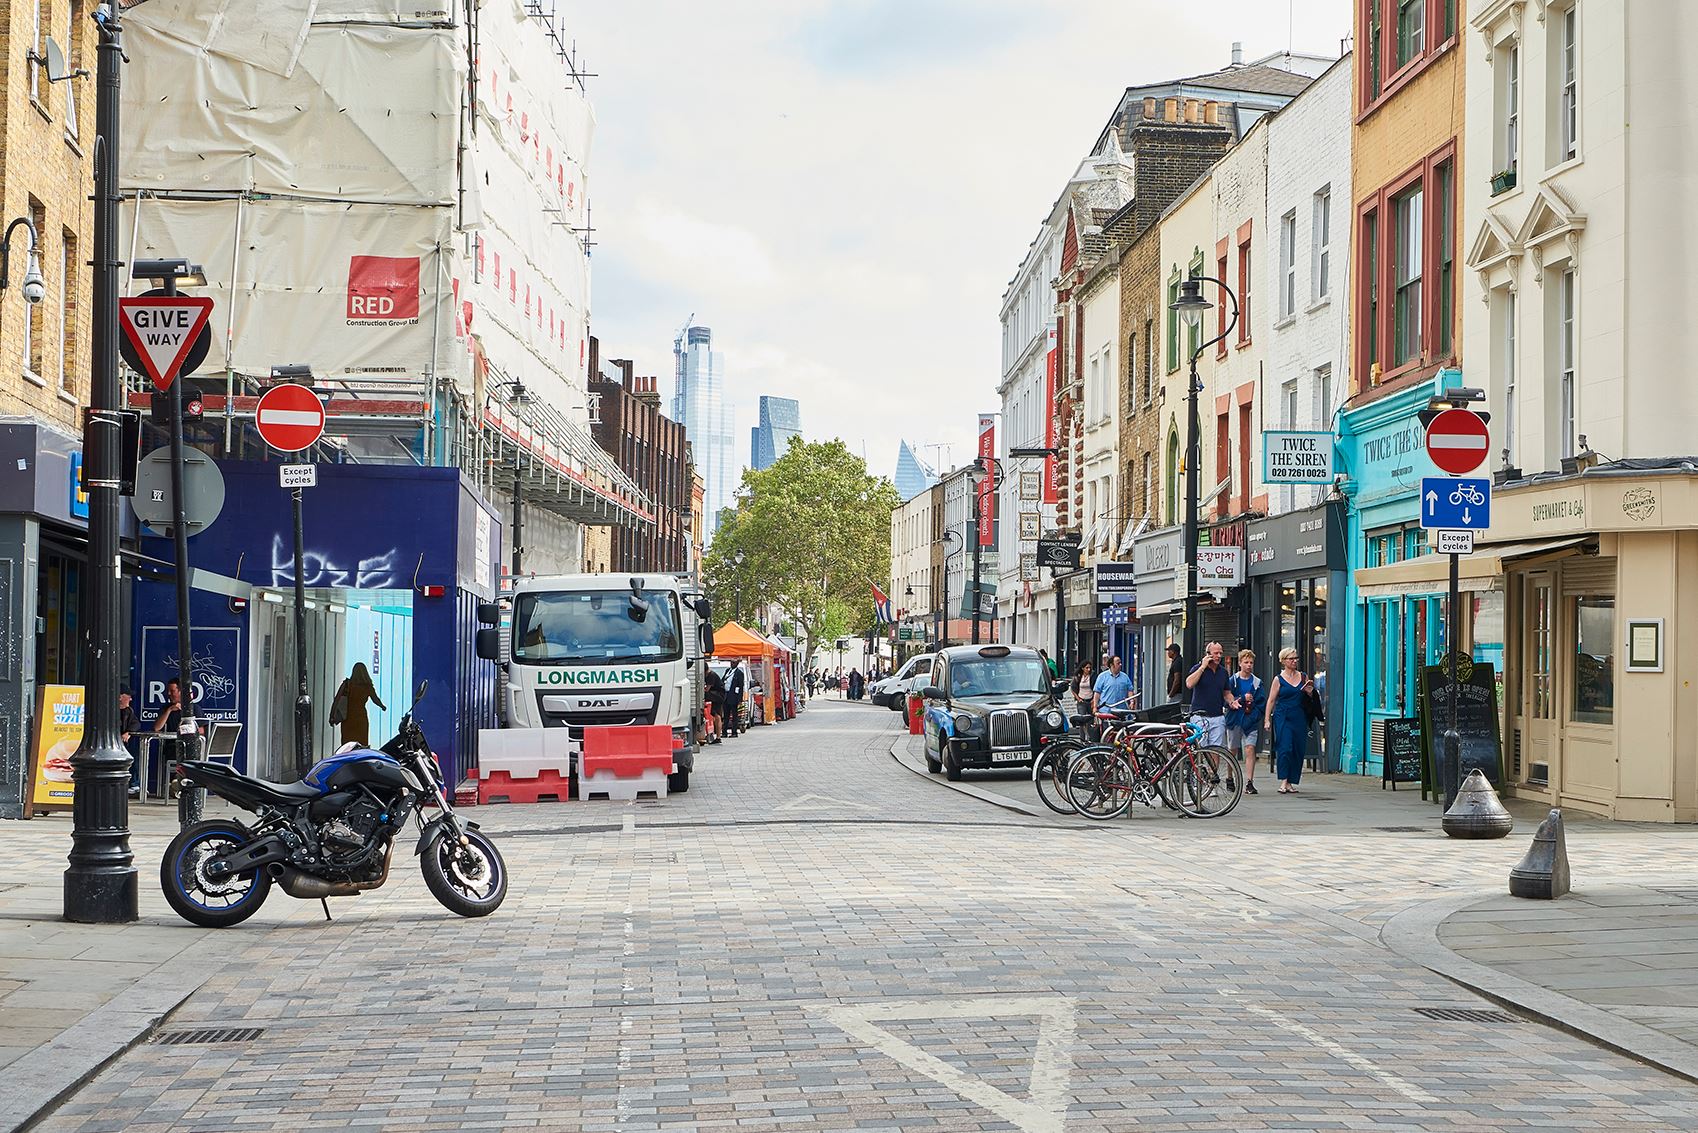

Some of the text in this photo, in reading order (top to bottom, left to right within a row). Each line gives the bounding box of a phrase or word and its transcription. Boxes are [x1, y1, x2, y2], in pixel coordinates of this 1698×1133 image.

[351, 296, 395, 315] RED
[134, 310, 189, 328] GIVE
[346, 319, 387, 327] Construction
[147, 333, 181, 346] WAY
[1281, 438, 1316, 451] TWICE
[1363, 435, 1391, 465] TWICE
[1393, 429, 1411, 456] THE
[1271, 453, 1327, 466] THE SIREN
[1272, 469, 1326, 477] 020 7261 0025
[1533, 501, 1567, 521] SUPERMARKET
[1622, 497, 1656, 512] GREENSMITHS
[1442, 534, 1470, 542] Except
[1442, 543, 1468, 551] cycles
[1215, 566, 1234, 575] Cha
[537, 669, 659, 684] LONGMARSH
[61, 693, 80, 703] START
[149, 681, 204, 704] RD
[53, 704, 77, 715] WITH
[53, 714, 84, 725] SIZZLE
